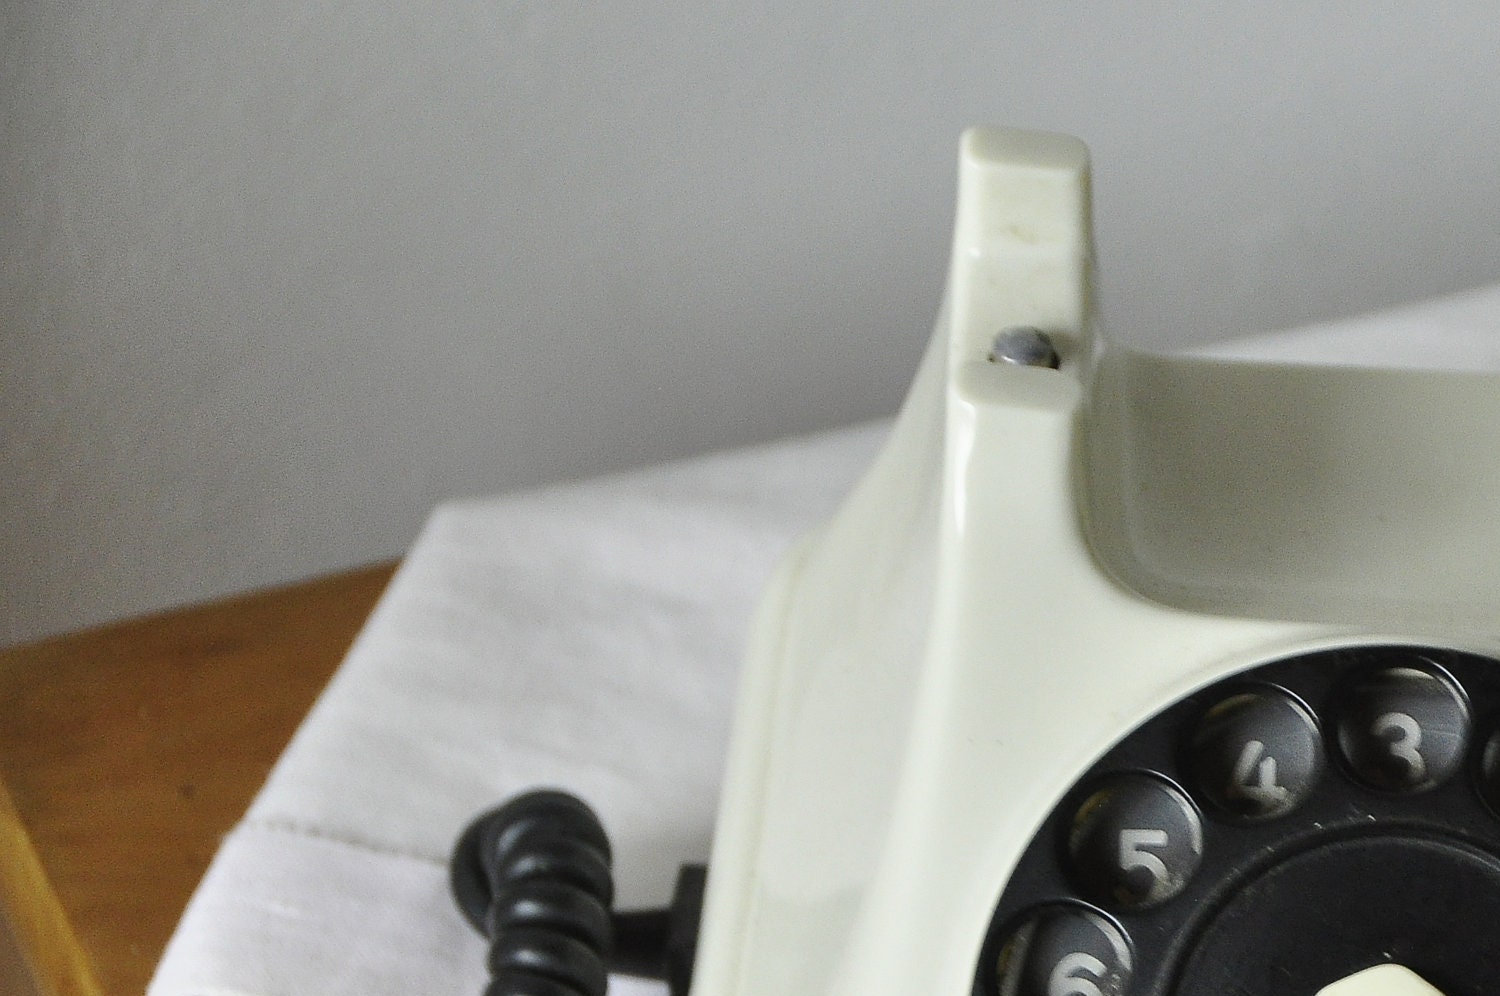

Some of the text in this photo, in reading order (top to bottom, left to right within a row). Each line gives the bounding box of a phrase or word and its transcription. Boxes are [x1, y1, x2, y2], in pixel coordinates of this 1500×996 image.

[1232, 740, 1294, 804] 4
[1371, 712, 1426, 784] 3
[1119, 828, 1173, 894] 5
